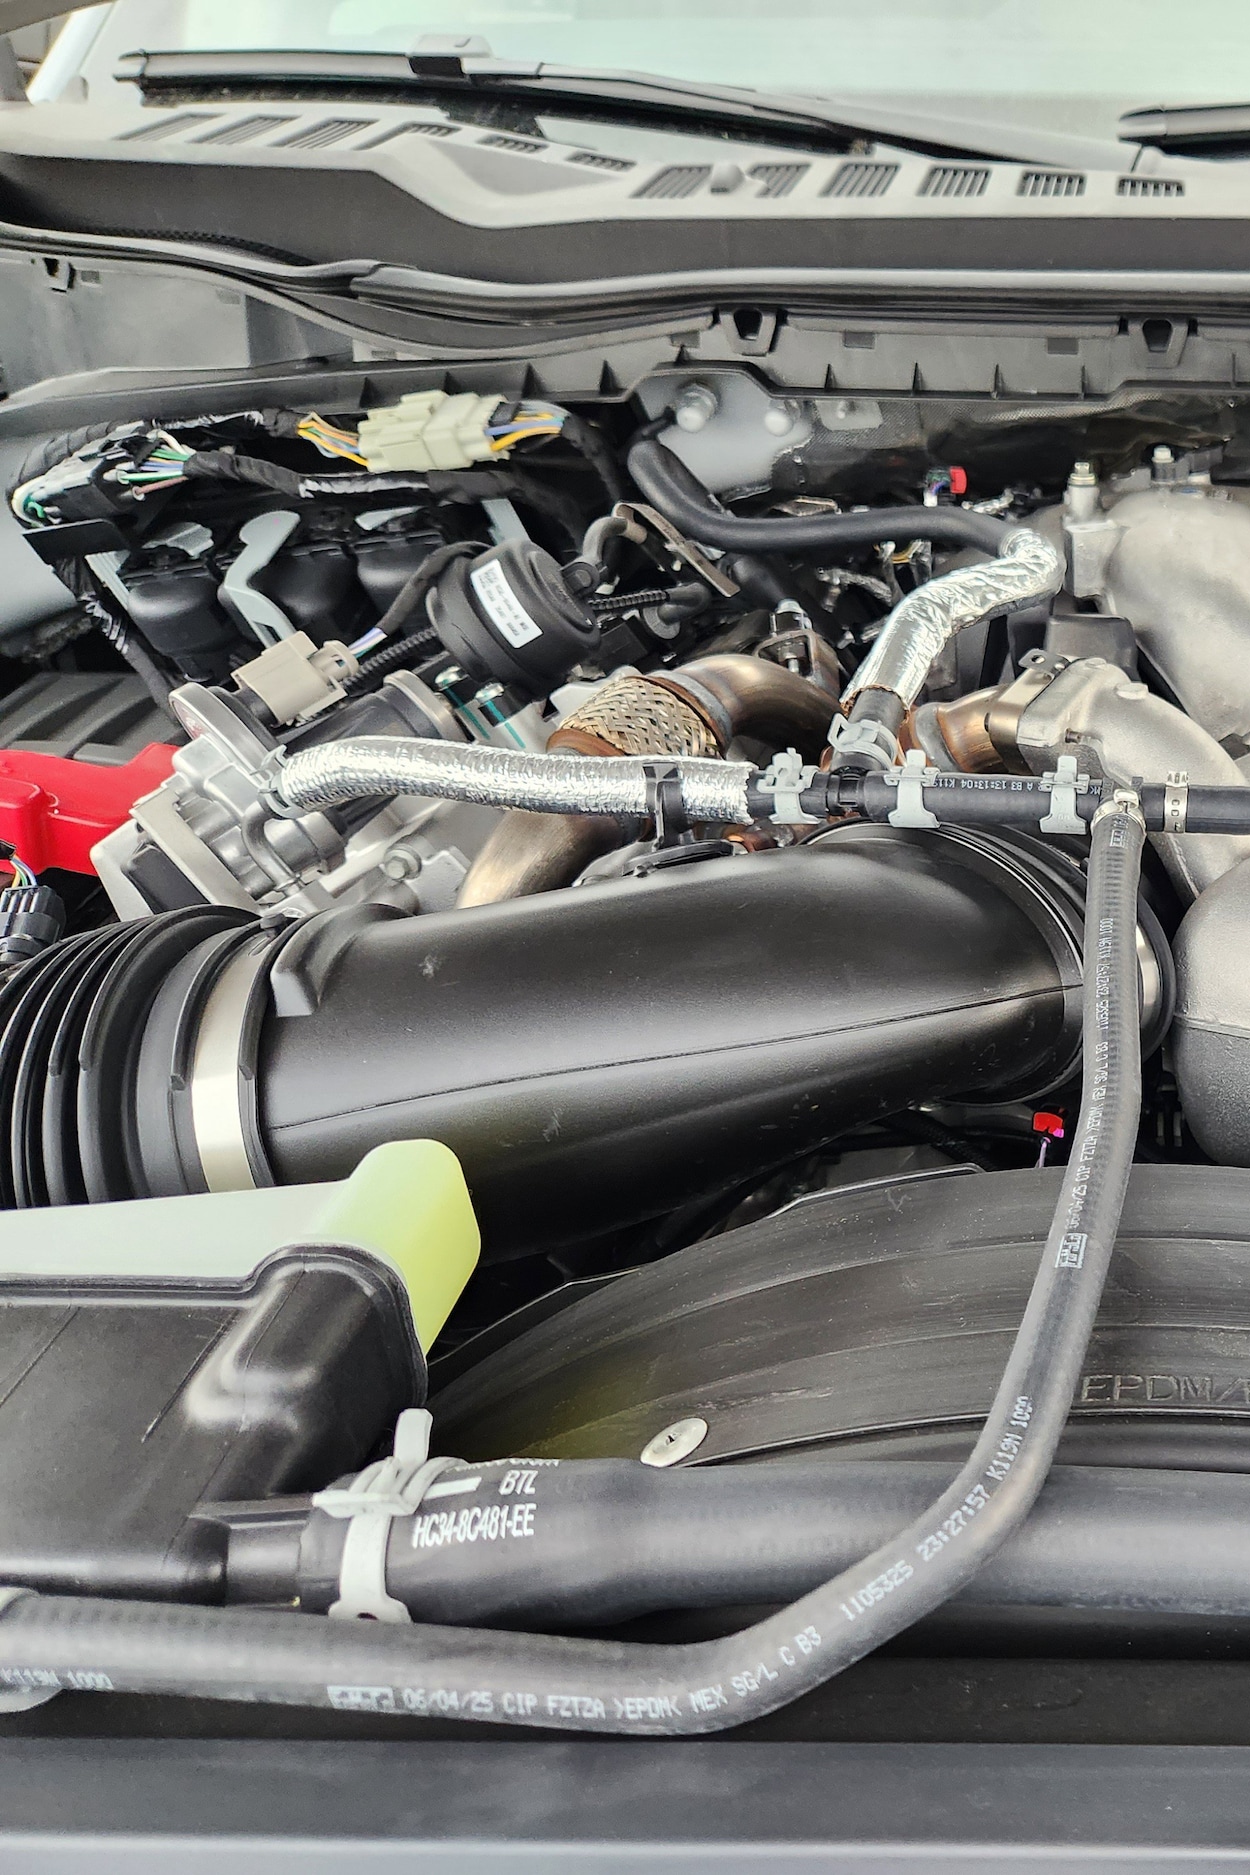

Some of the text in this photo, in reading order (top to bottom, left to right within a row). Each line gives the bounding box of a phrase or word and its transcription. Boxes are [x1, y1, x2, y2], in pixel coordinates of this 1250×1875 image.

[961, 780, 1007, 791] 13:13:04
[1075, 1165, 1091, 1182] CIP
[499, 1469, 538, 1495] BTL
[411, 1503, 537, 1549] HC34-8C481-EE
[501, 1692, 538, 1715] CIP
[689, 1684, 729, 1714] MEX
[730, 1662, 779, 1698] SG/L
[778, 1645, 796, 1666] C
[794, 1625, 822, 1655] B3
[840, 1559, 914, 1621] 1105325
[916, 1483, 991, 1562] 23:27:57
